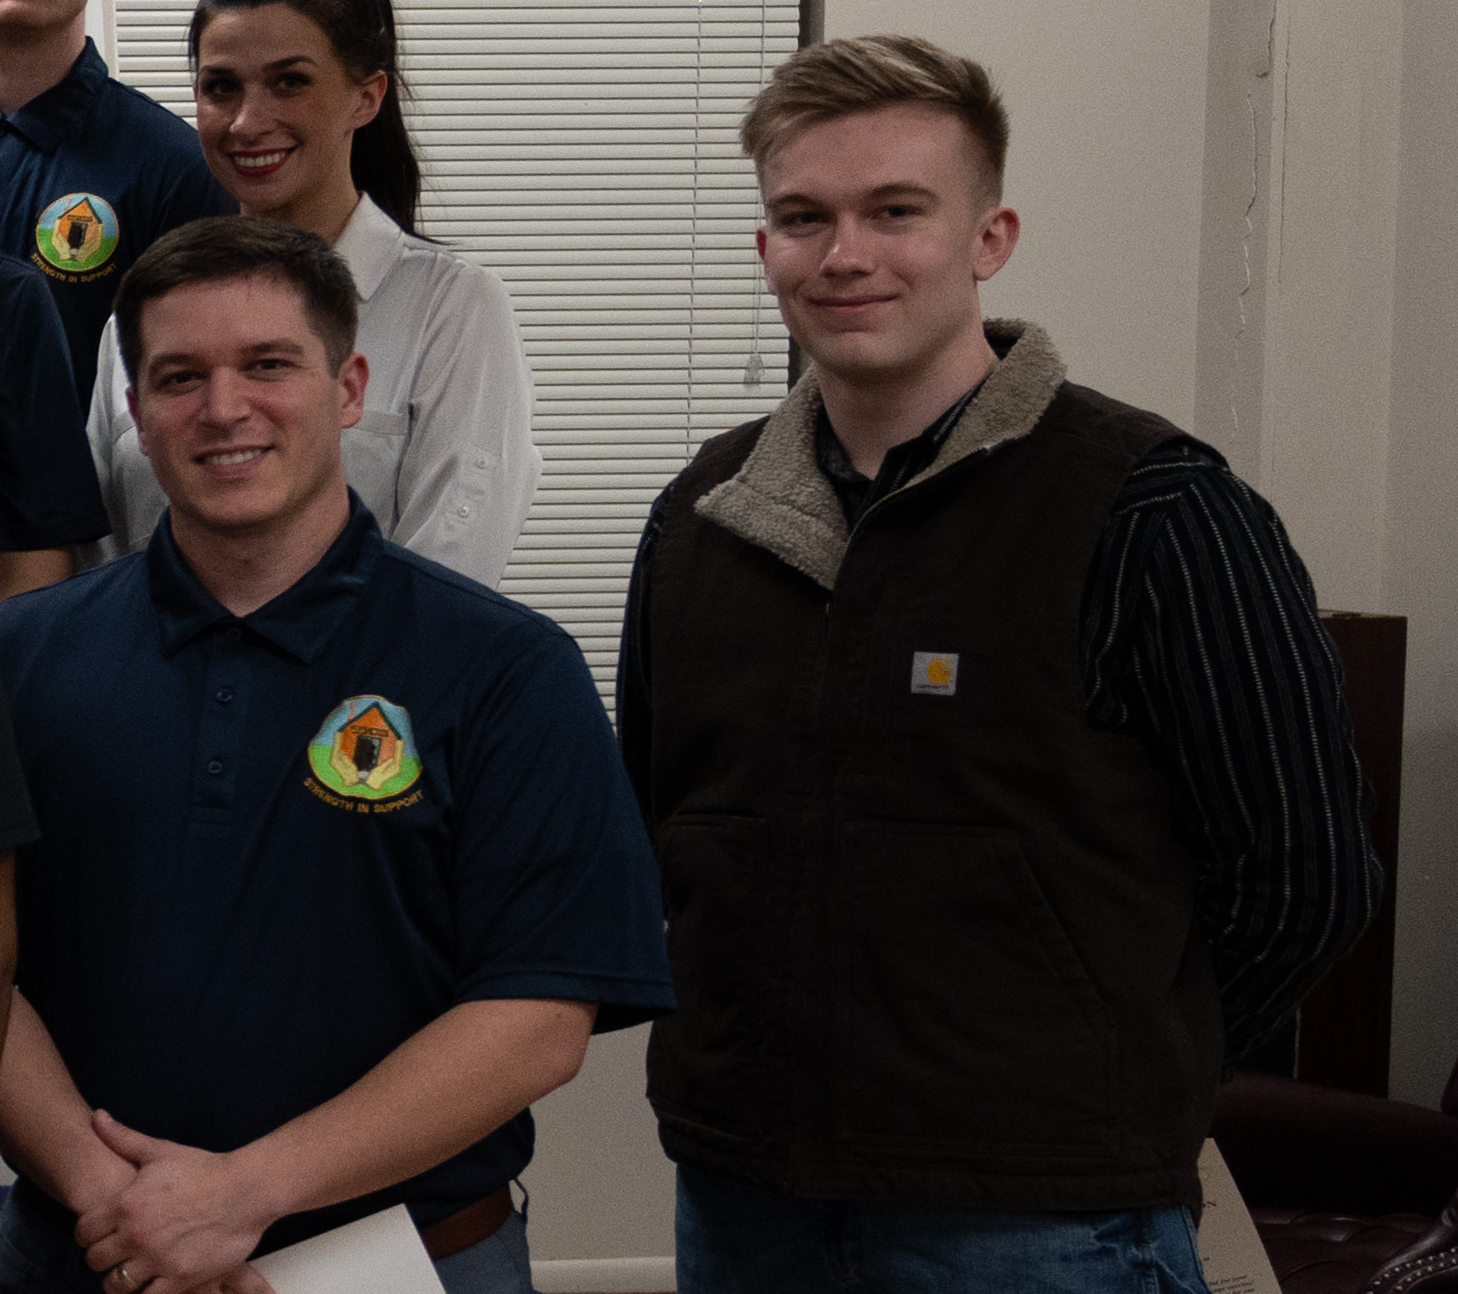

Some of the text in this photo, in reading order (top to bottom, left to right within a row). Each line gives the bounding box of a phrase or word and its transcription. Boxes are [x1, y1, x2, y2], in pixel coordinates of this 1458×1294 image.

[303, 777, 424, 813] STRENGTH IN SUPPORT
